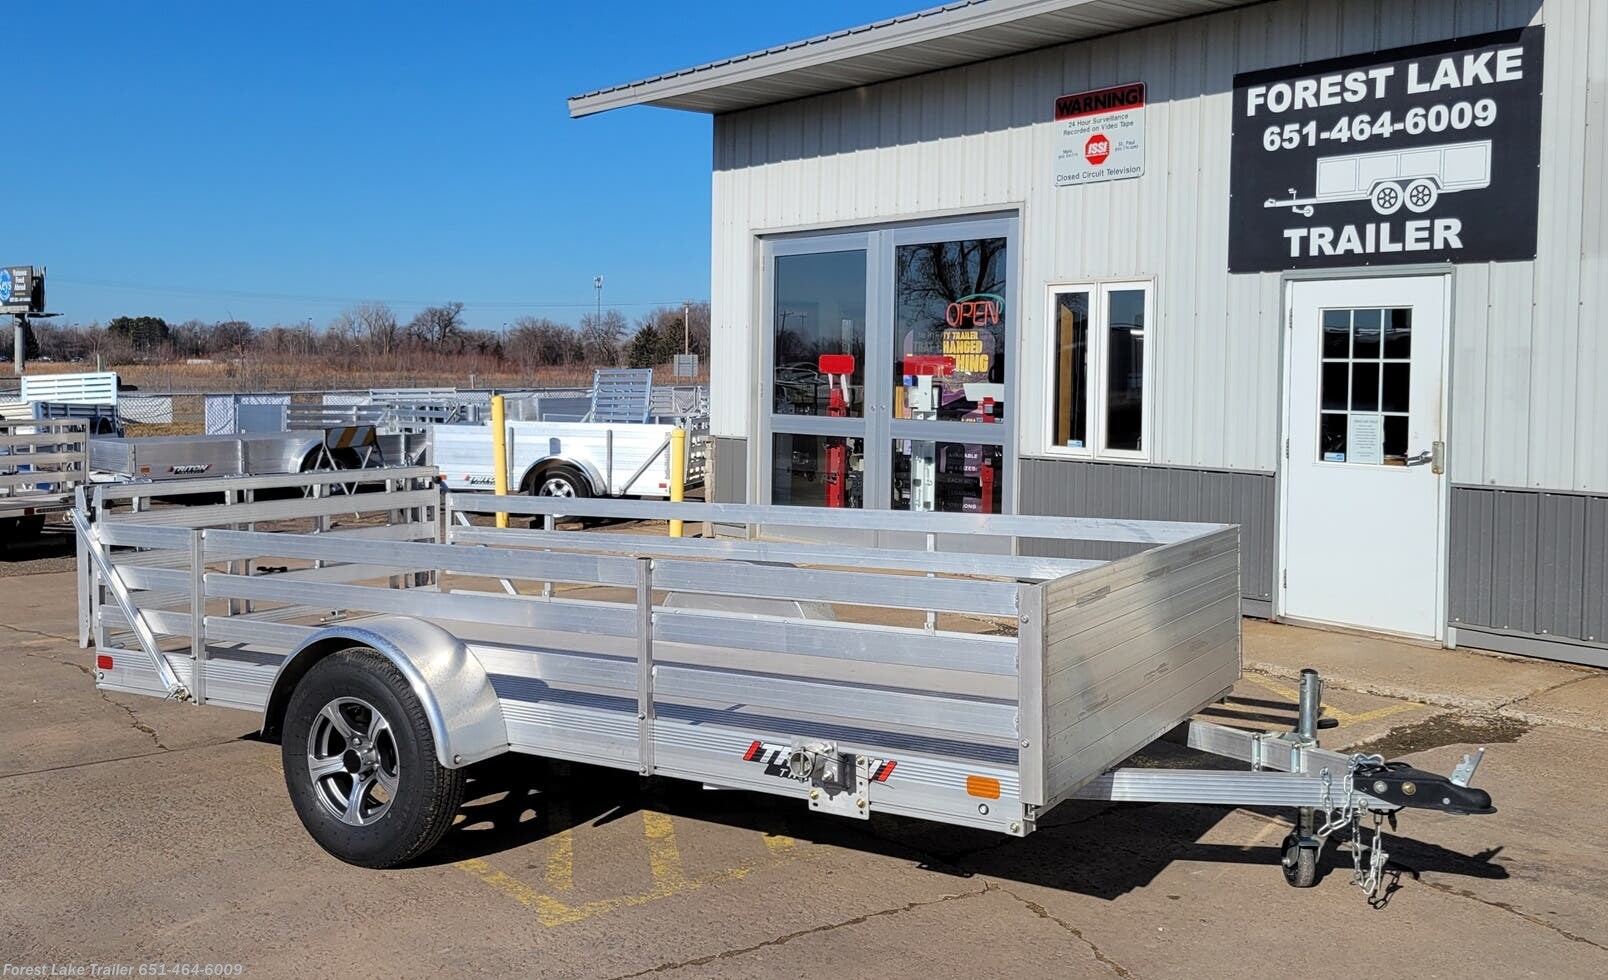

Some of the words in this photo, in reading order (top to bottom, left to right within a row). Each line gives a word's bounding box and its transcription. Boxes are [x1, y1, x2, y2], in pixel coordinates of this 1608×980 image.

[1247, 66, 1394, 117] FOREST
[1407, 47, 1523, 95] LAKE
[1058, 87, 1143, 115] WARNING!
[1063, 127, 1090, 136] Recorded
[1120, 120, 1134, 128] Tape
[1093, 114, 1129, 124] Surveillance
[1263, 98, 1497, 151] 651-464-6009
[1056, 173, 1080, 182] Closed
[1082, 169, 1104, 179] Circuit
[1107, 165, 1141, 176] Television
[1284, 217, 1464, 258] TRAILER
[946, 301, 1000, 327] OPEN
[951, 331, 979, 339] TRAILER
[941, 340, 983, 354] HANGED
